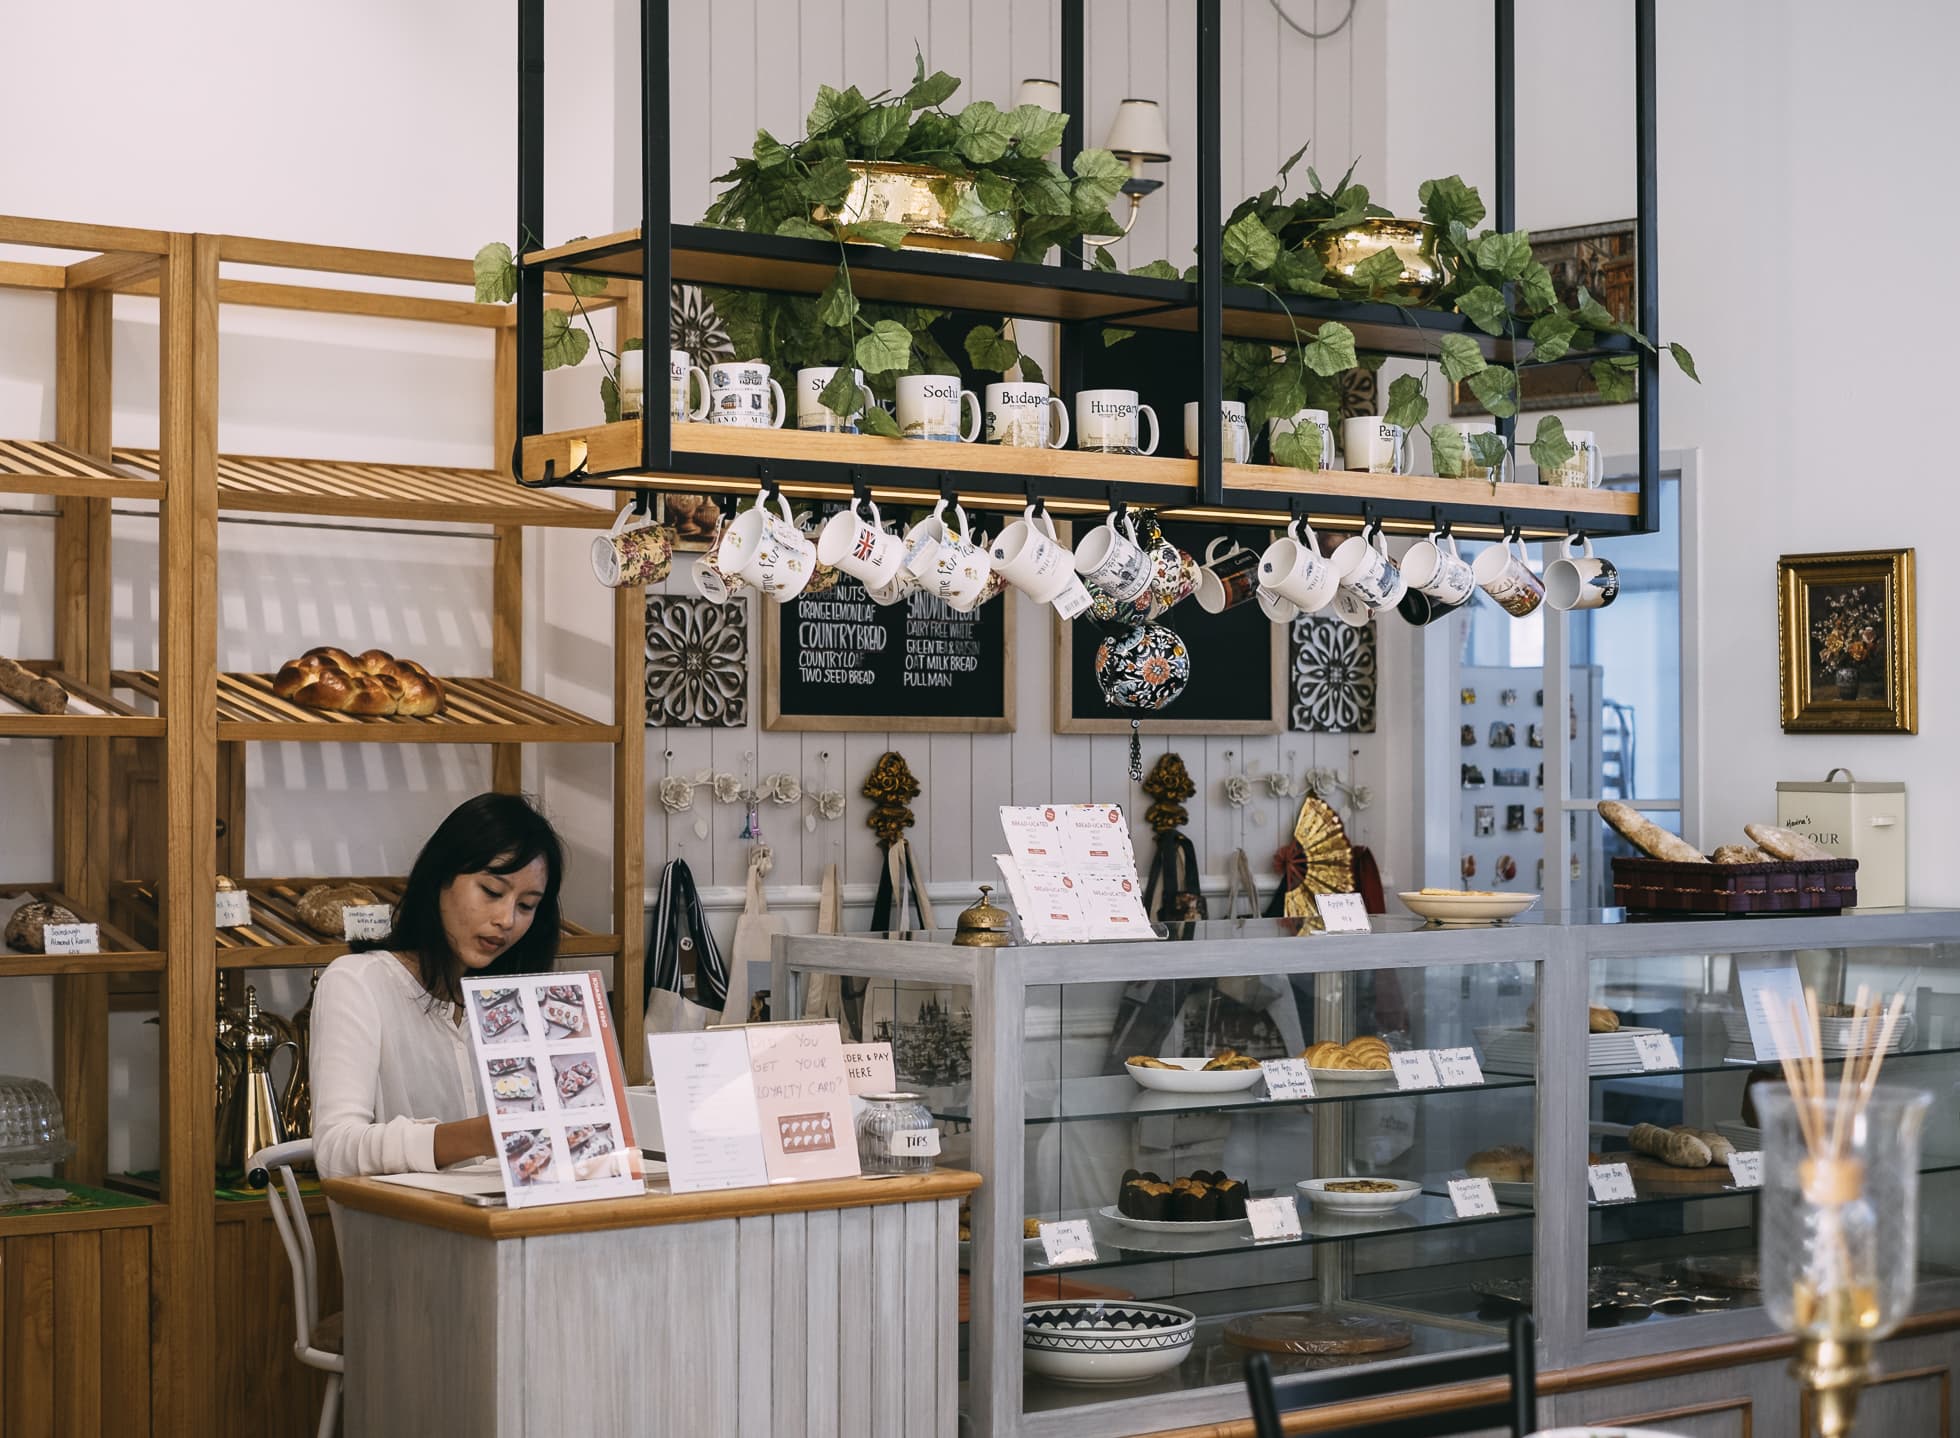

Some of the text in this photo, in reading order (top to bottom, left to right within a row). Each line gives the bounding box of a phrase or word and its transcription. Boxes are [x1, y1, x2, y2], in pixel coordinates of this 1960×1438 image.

[923, 384, 958, 399] Sochi
[1002, 391, 1050, 407] Budapes
[798, 600, 831, 620] ORANGE
[799, 622, 887, 651] COUNTRY BREAD
[907, 620, 974, 640] DAIRY FREE WHITE
[906, 639, 935, 654] GREEN
[799, 650, 843, 668] COUNTRY
[905, 655, 977, 672] OAT MILK BREAD
[799, 667, 875, 684] TWO SEED BREAD
[903, 672, 952, 687] PULLMAN
[752, 1057, 827, 1073] GET YOUR
[845, 1054, 864, 1063] DER
[873, 1052, 889, 1062] PAY
[848, 1066, 873, 1079] HERE
[757, 1076, 843, 1100] LOYALTY CARD?
